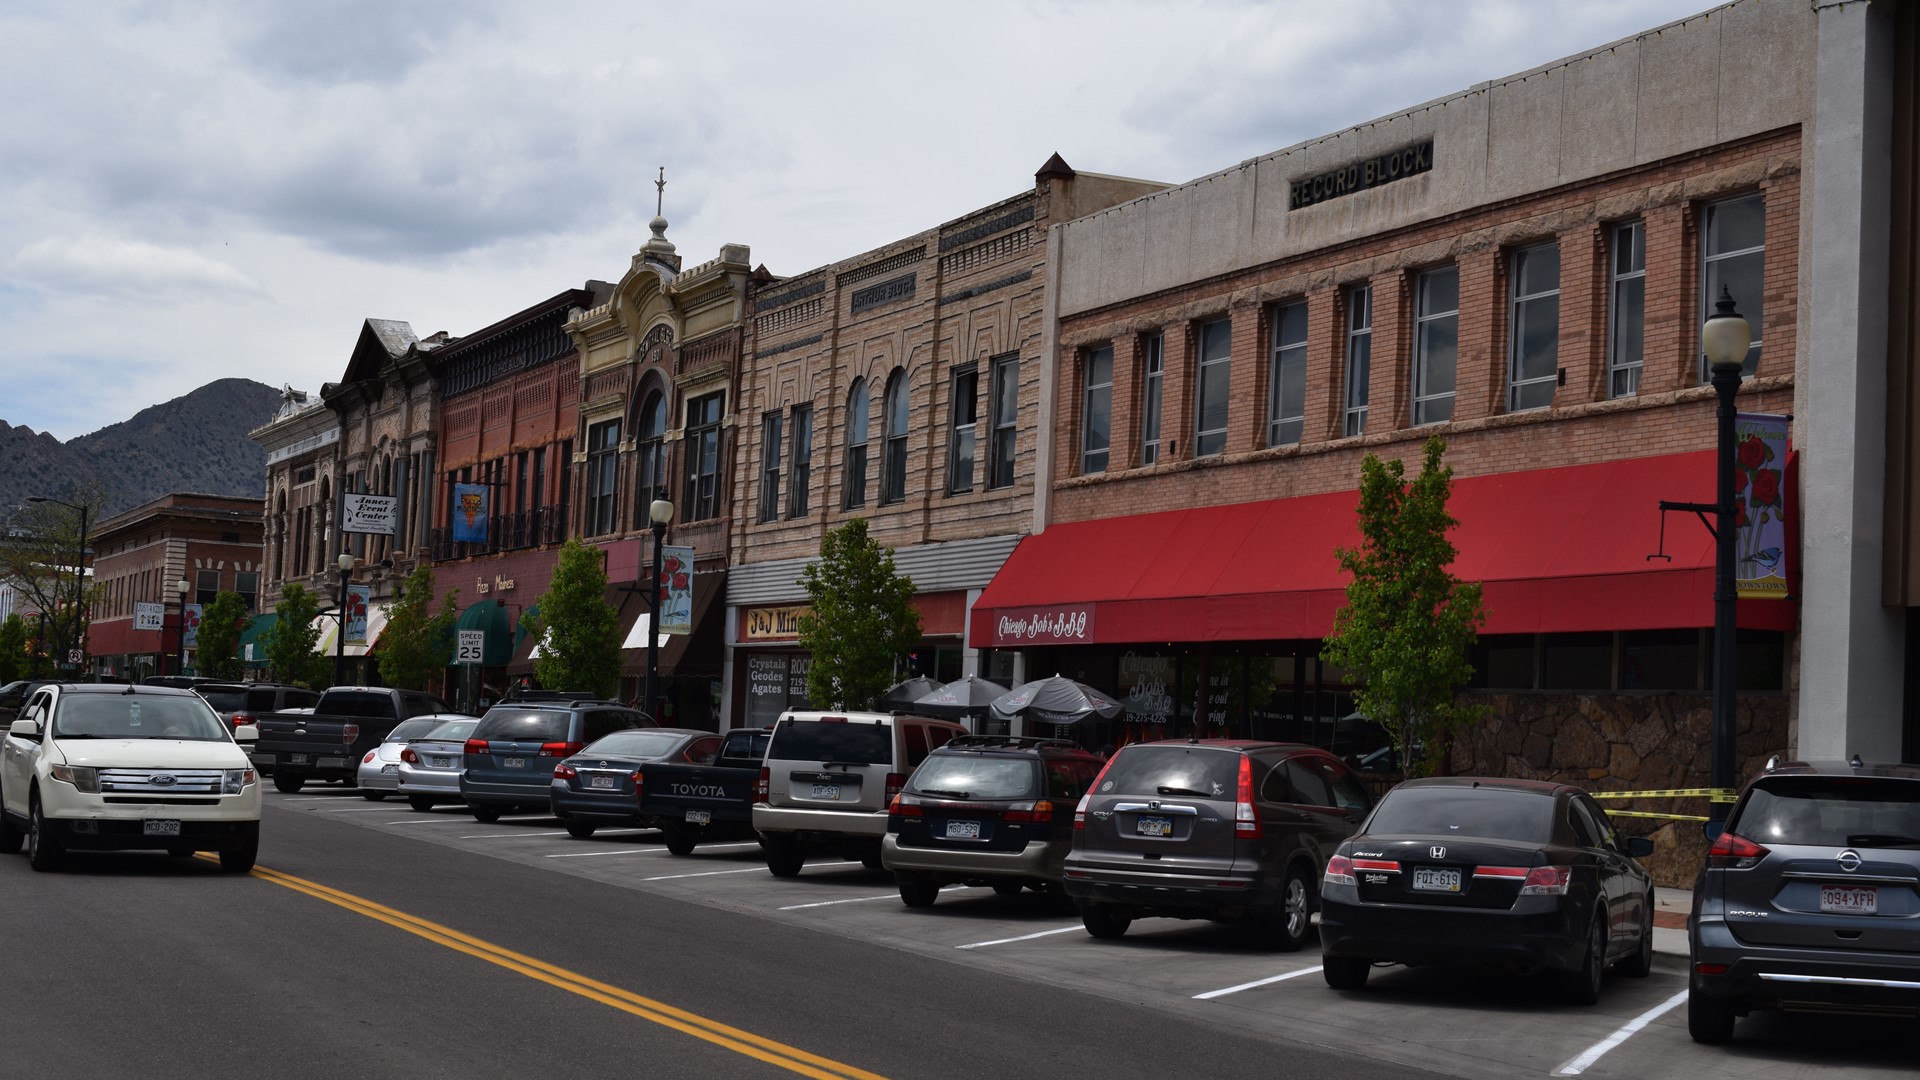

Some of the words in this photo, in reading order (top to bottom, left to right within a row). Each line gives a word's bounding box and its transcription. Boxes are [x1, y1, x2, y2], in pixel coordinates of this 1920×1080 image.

[1291, 166, 1358, 206] RECORD
[855, 288, 886, 310] ARTHUR
[888, 277, 917, 299] BLOCK
[1738, 421, 1786, 443] Welcome
[355, 497, 391, 505] Annex
[362, 504, 388, 512] Event
[495, 574, 515, 591] Madness
[1736, 582, 1786, 590] DOWNTOWN
[751, 612, 774, 634] J&J
[999, 616, 1027, 640] Chicago
[1027, 613, 1053, 638] Bob's
[460, 647, 481, 659] 25
[749, 658, 786, 673] Crystals
[1122, 650, 1167, 679] Chicago
[751, 671, 784, 682] Geodes
[752, 684, 782, 696] Agates
[1129, 673, 1166, 702] Bob's
[1122, 711, 1167, 723] 19-275-4226
[671, 783, 726, 798] TOYOTA
[1730, 910, 1769, 918] ROGUE
